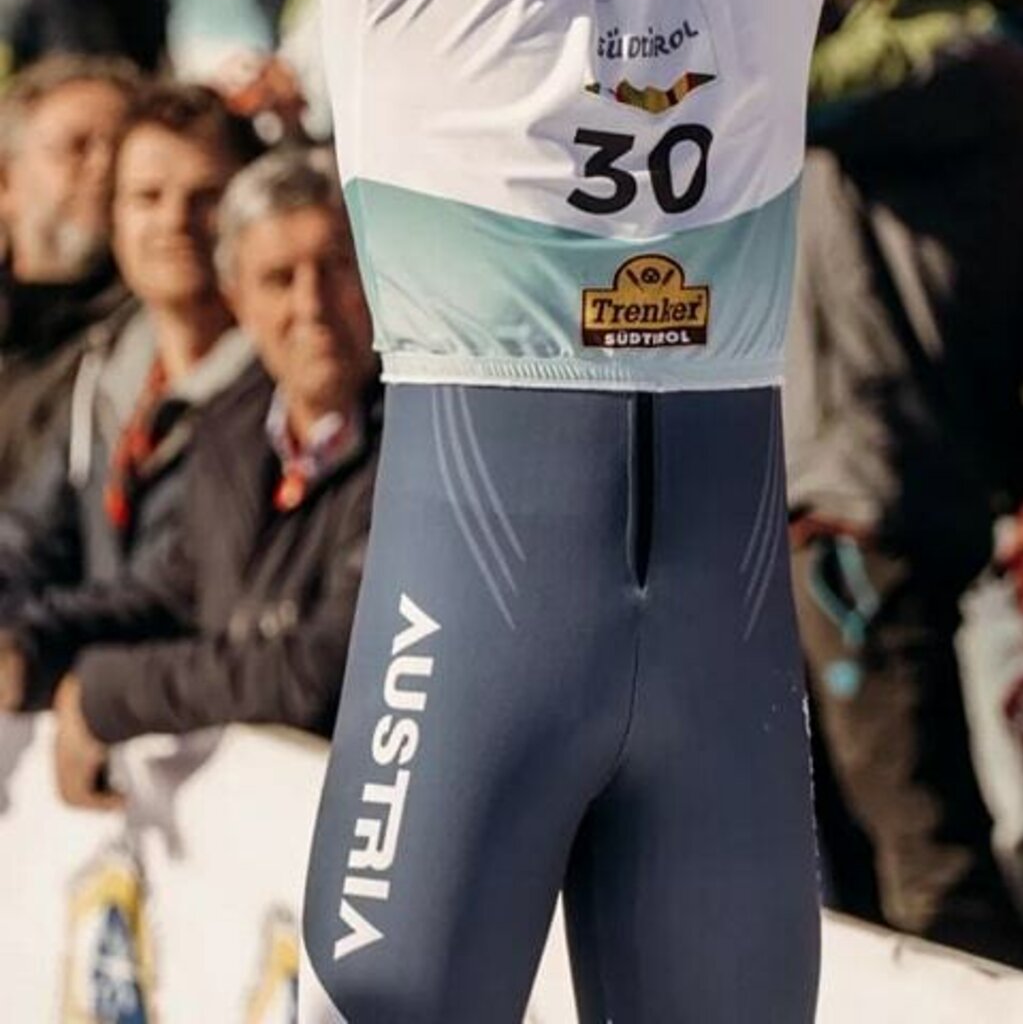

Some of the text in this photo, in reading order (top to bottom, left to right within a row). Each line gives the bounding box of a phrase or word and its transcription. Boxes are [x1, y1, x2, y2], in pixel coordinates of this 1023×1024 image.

[566, 123, 713, 214] 30
[592, 295, 702, 324] Trenker
[333, 592, 442, 960] AUSTRIA
